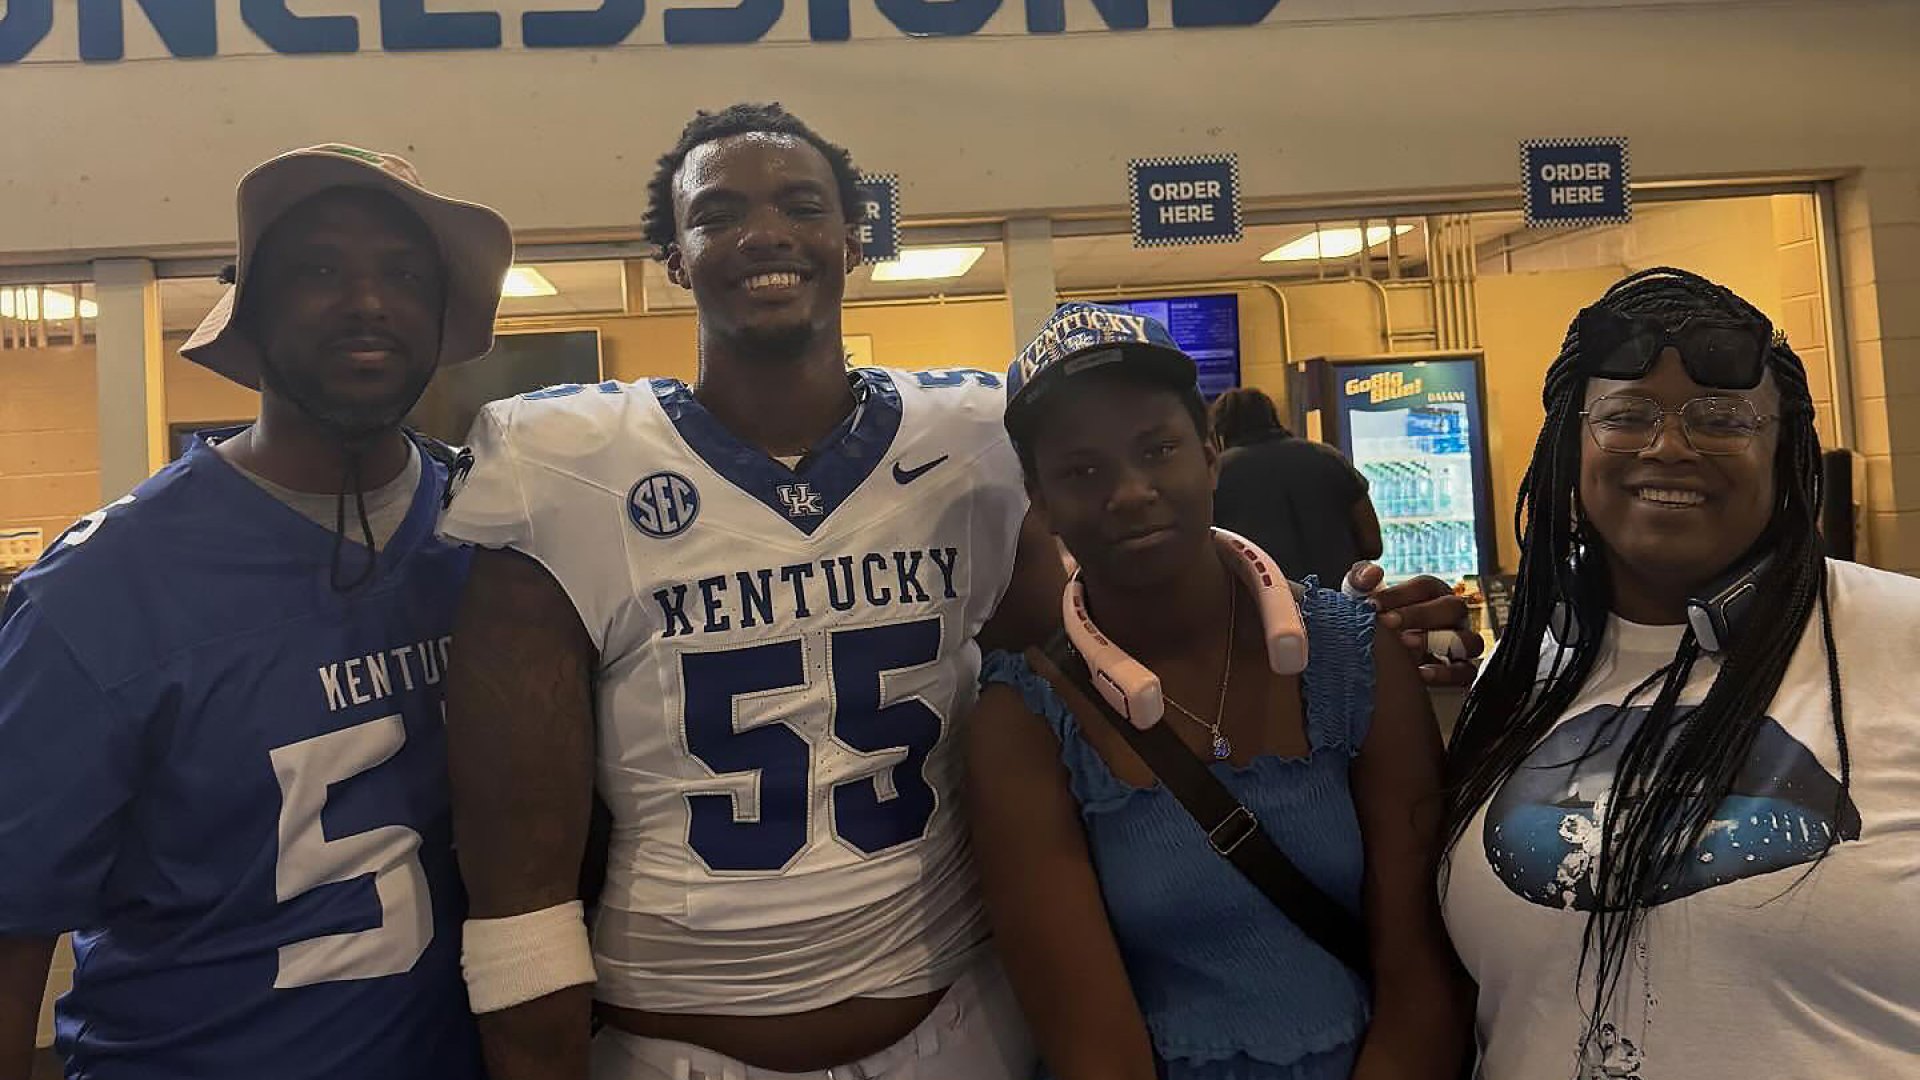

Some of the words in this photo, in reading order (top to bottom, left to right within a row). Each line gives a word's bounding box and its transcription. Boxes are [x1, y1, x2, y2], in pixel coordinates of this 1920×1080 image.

[1541, 162, 1611, 182] ORDER
[1149, 180, 1221, 201] ORDER
[1551, 185, 1605, 205] HERE
[1159, 203, 1215, 224] HERE
[1020, 310, 1150, 382] KENTUCKY
[633, 475, 695, 534] SEC
[776, 483, 824, 517] UK
[652, 546, 958, 639] KENTUCKY
[677, 614, 943, 876] 55
